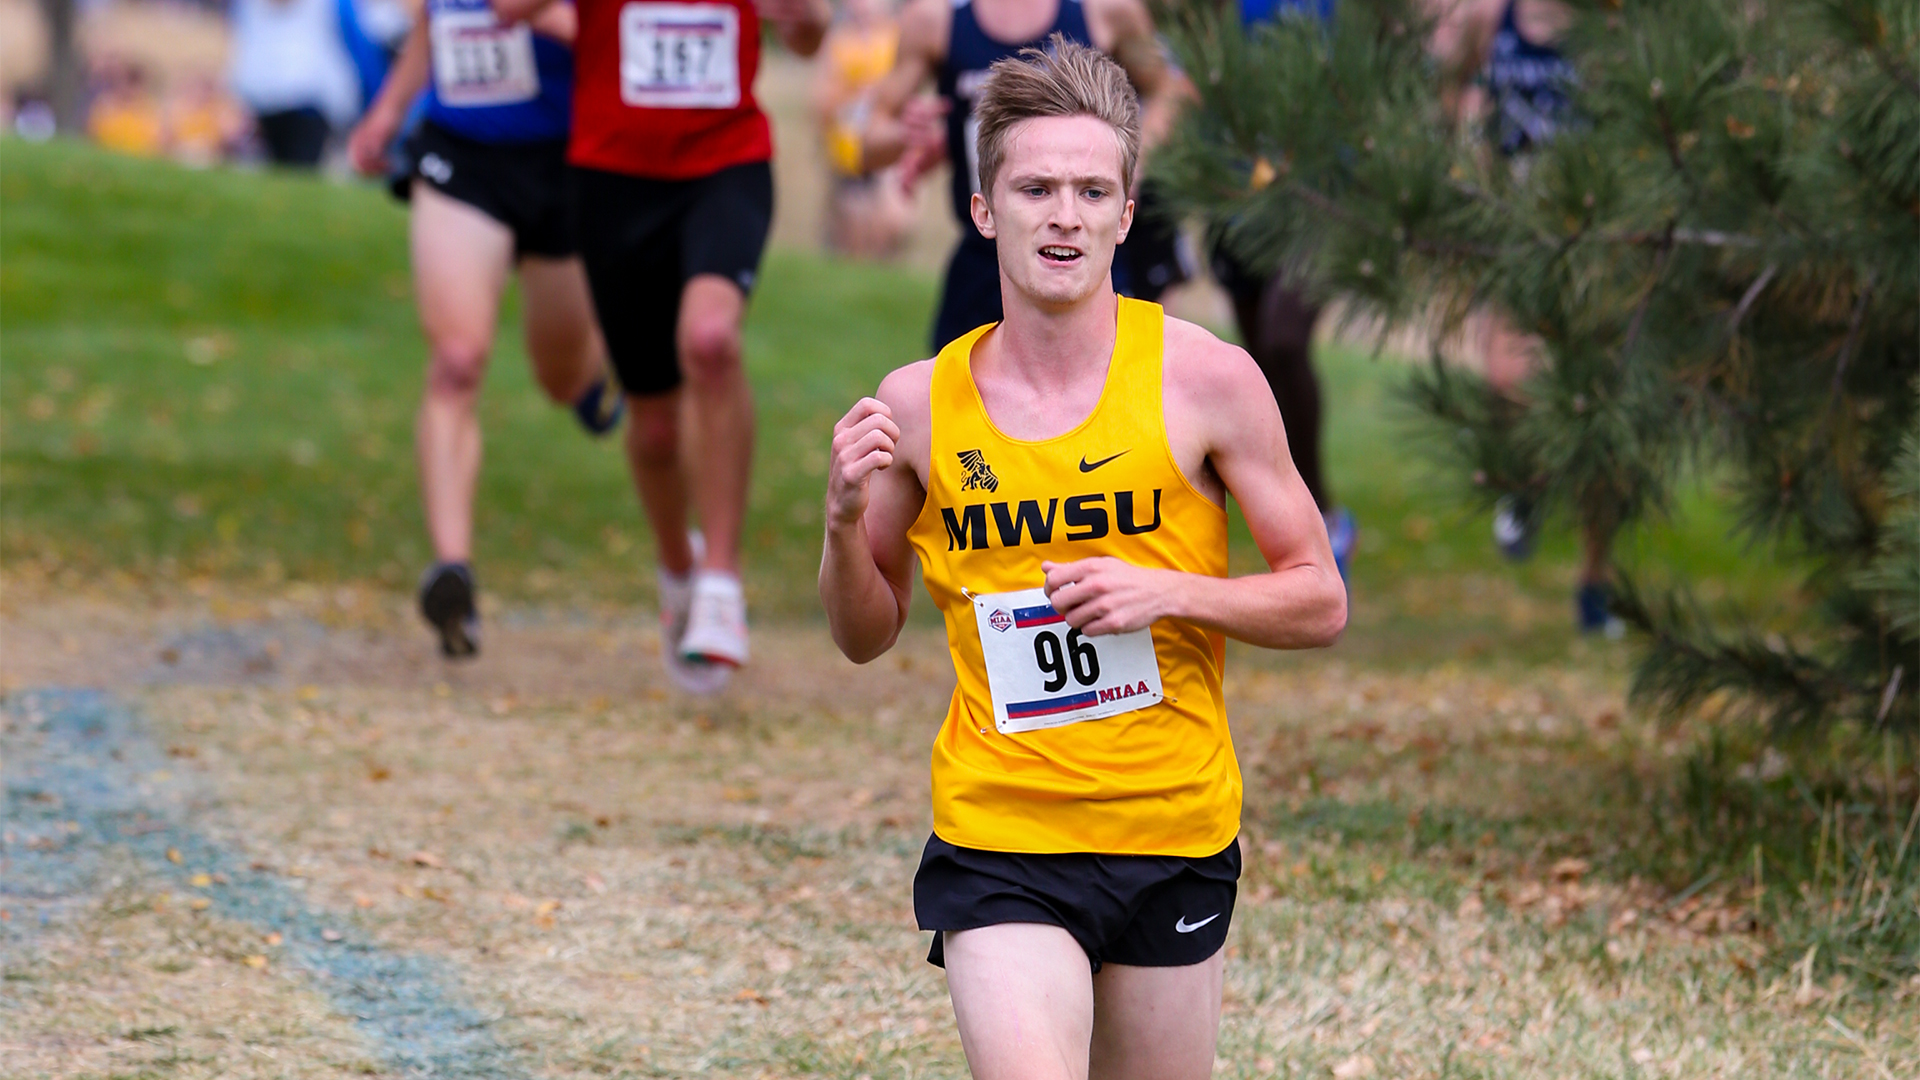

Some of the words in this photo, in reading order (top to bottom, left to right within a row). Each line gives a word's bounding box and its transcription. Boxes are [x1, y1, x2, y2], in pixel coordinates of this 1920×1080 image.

[941, 488, 1162, 551] MWSU
[990, 616, 1011, 625] MIAA
[1034, 628, 1100, 692] 96
[1099, 680, 1149, 703] MIAA
